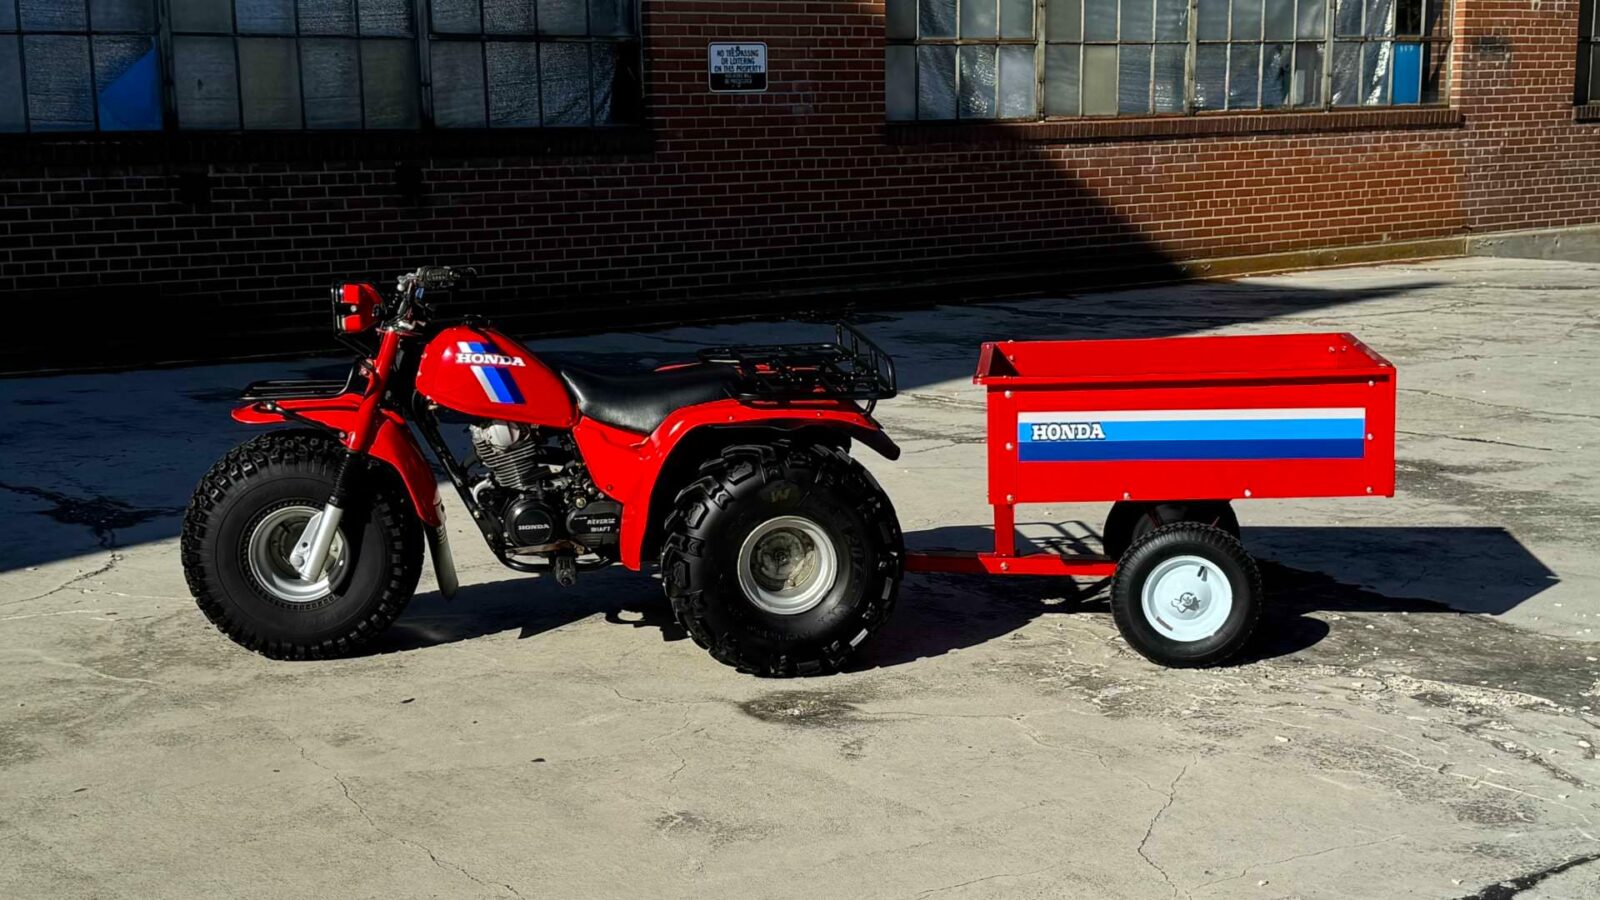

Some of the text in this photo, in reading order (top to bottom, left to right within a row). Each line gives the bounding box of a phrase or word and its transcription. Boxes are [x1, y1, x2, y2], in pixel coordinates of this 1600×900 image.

[721, 57, 729, 65] OR
[455, 353, 526, 367] HONDA
[1031, 422, 1106, 441] HONDA
[518, 523, 550, 531] HONDA
